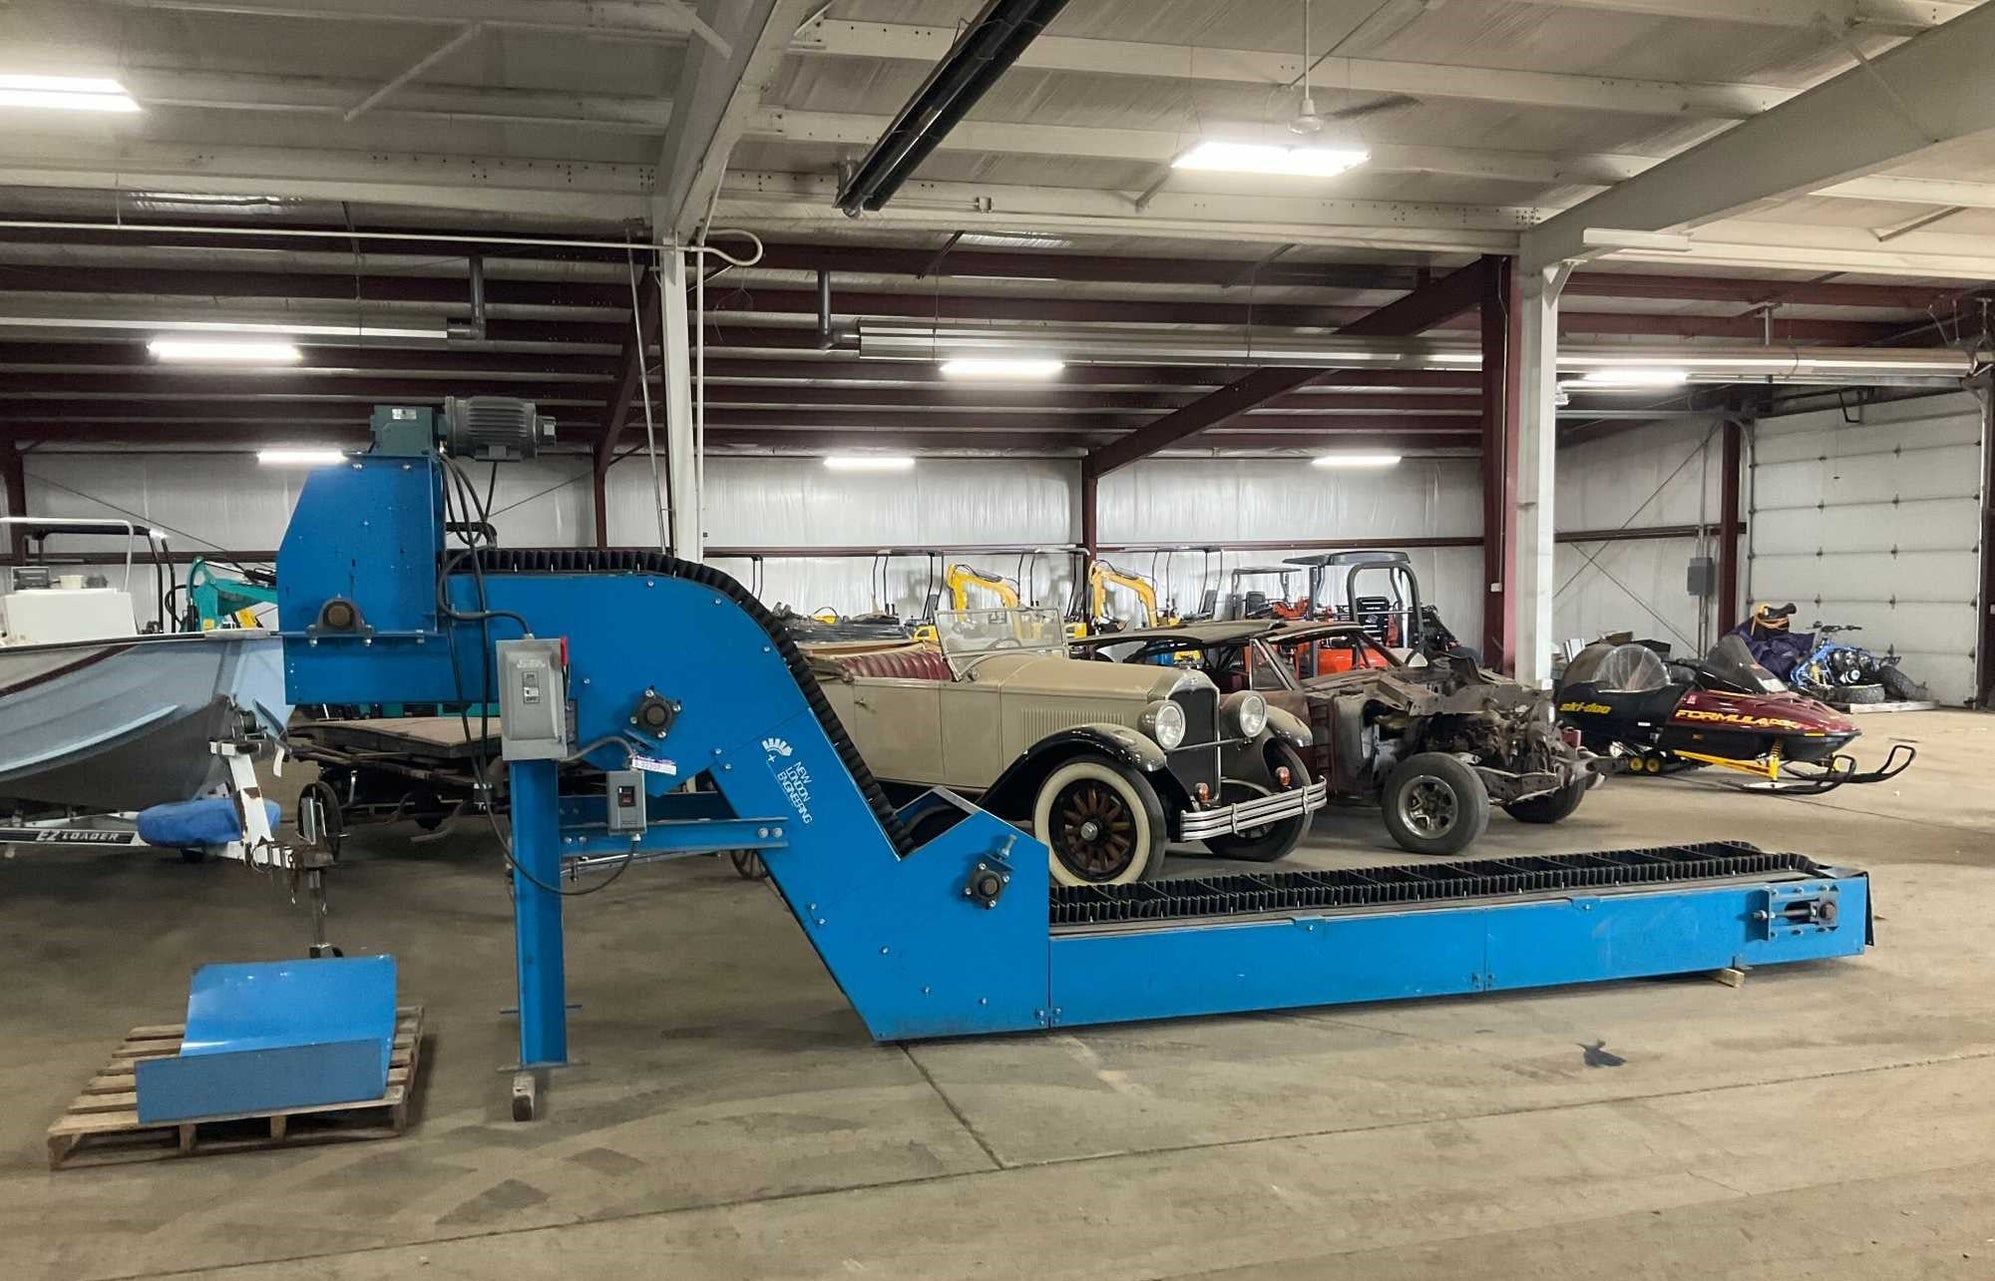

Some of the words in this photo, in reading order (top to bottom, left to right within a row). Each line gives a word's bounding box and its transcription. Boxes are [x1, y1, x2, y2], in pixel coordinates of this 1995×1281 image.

[1559, 702, 1612, 714] ski-doo
[1675, 709, 1769, 727] FORMULA
[793, 761, 812, 784] NEW
[786, 766, 811, 802] LONDON
[777, 771, 813, 824] ENGINEERING
[36, 829, 61, 842] EZ
[62, 832, 119, 841] LOADER
